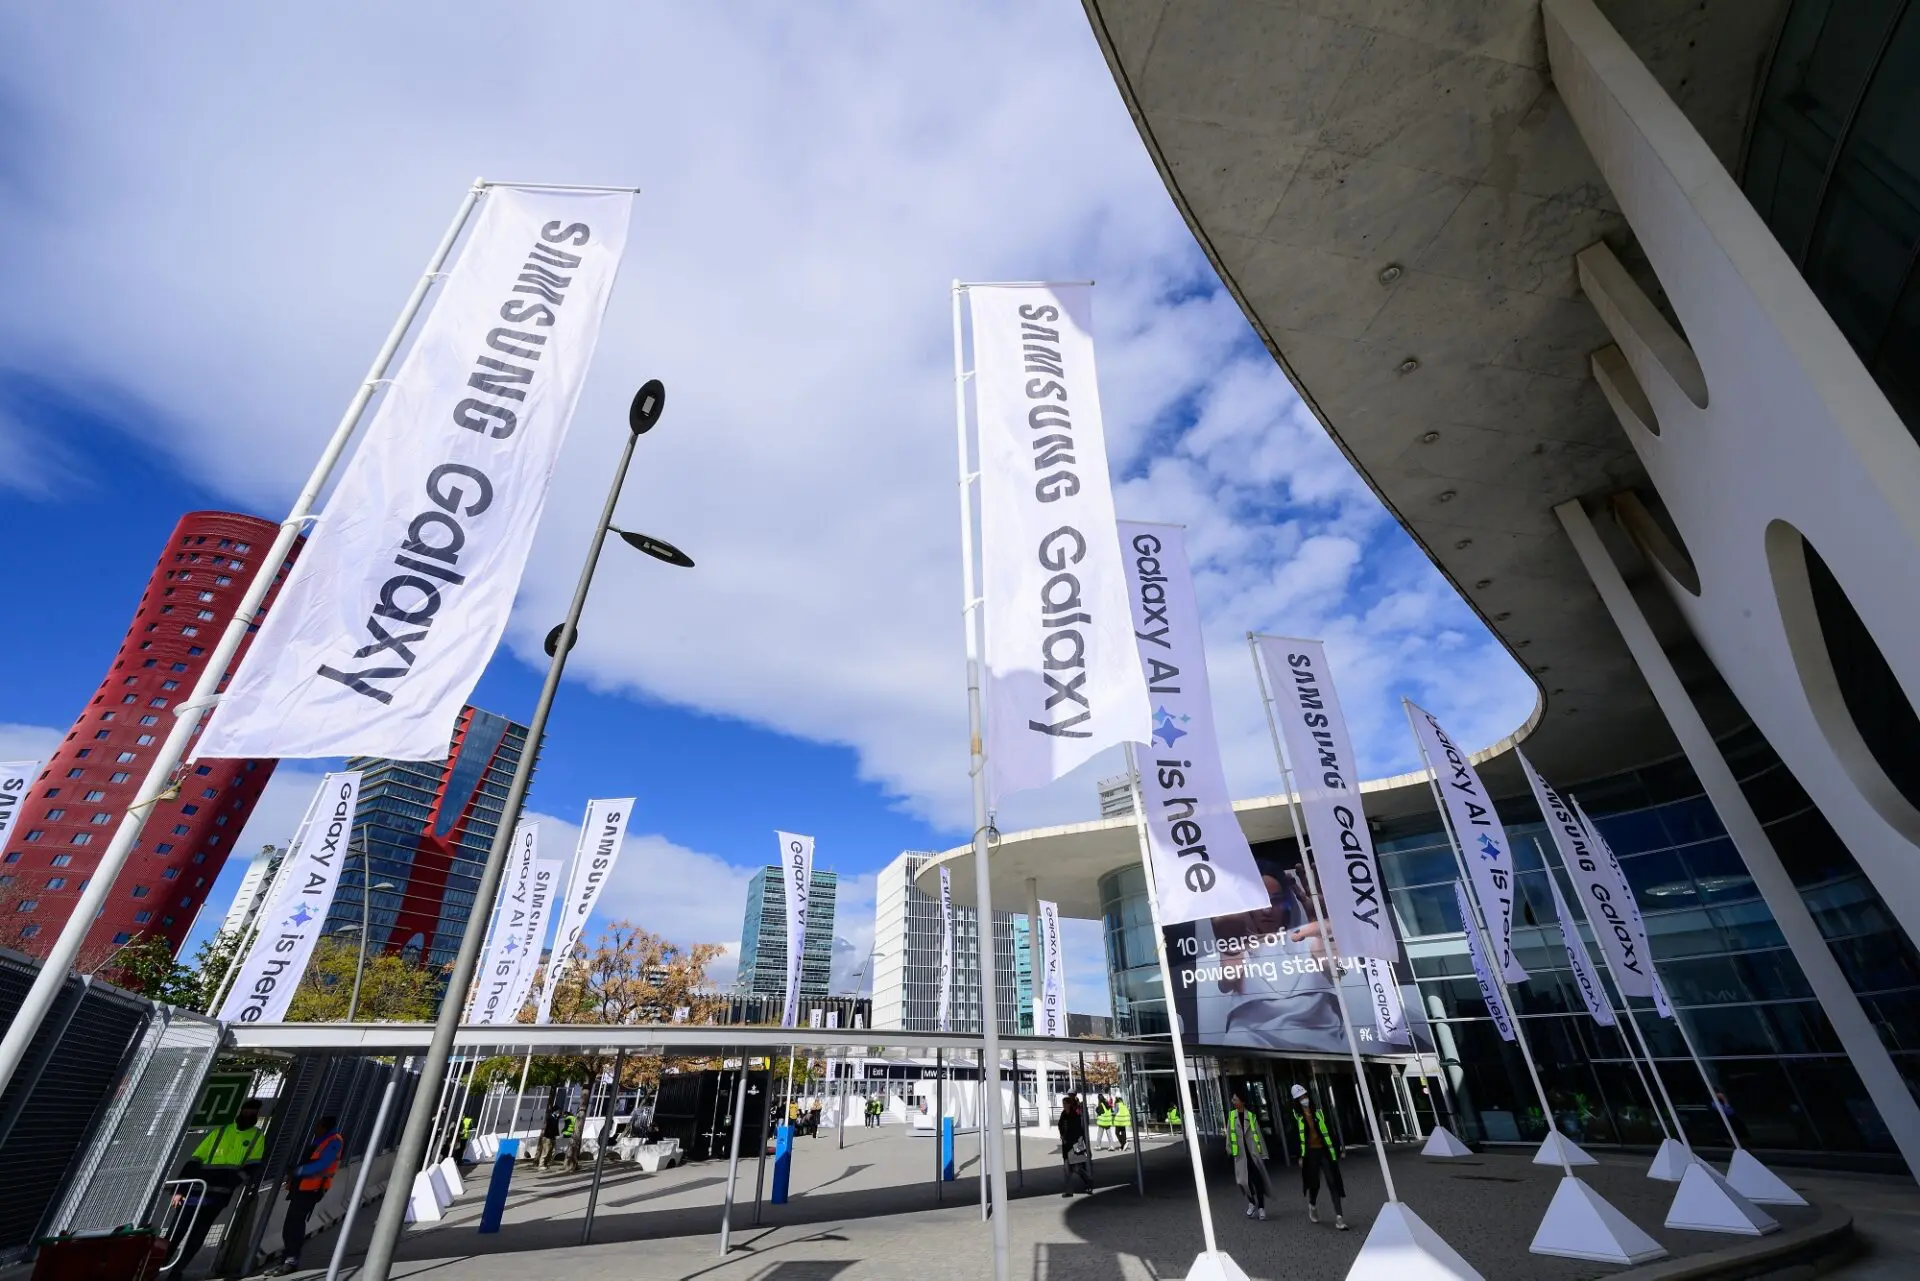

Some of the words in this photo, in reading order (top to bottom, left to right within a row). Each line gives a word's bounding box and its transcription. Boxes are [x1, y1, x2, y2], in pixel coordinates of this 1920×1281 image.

[453, 220, 590, 440] SAMSUNG
[1018, 303, 1080, 503] SAMSUNG
[317, 463, 494, 704] Galaxy
[1132, 534, 1172, 649] Galaxy
[1028, 525, 1093, 738] Galaxy
[1147, 658, 1181, 694] AI
[1157, 759, 1184, 789] is
[1287, 653, 1347, 790] SAMSUNG
[1336, 805, 1380, 930] Galaxy
[310, 782, 352, 867] Galaxy
[1163, 796, 1216, 893] here
[1464, 801, 1491, 826] AI
[1489, 867, 1508, 890] is
[302, 872, 326, 895] AI
[511, 832, 533, 904] Galaxy
[275, 934, 304, 953] is
[509, 909, 525, 927] AI
[1176, 936, 1198, 957] 10
[1203, 933, 1261, 958] years
[1264, 927, 1287, 945] of
[1591, 882, 1643, 976] Galaxy
[240, 959, 290, 1023] here
[495, 959, 515, 976] is
[1182, 957, 1278, 988] powering
[1281, 954, 1367, 976] starup
[872, 1068, 884, 1076] Exit
